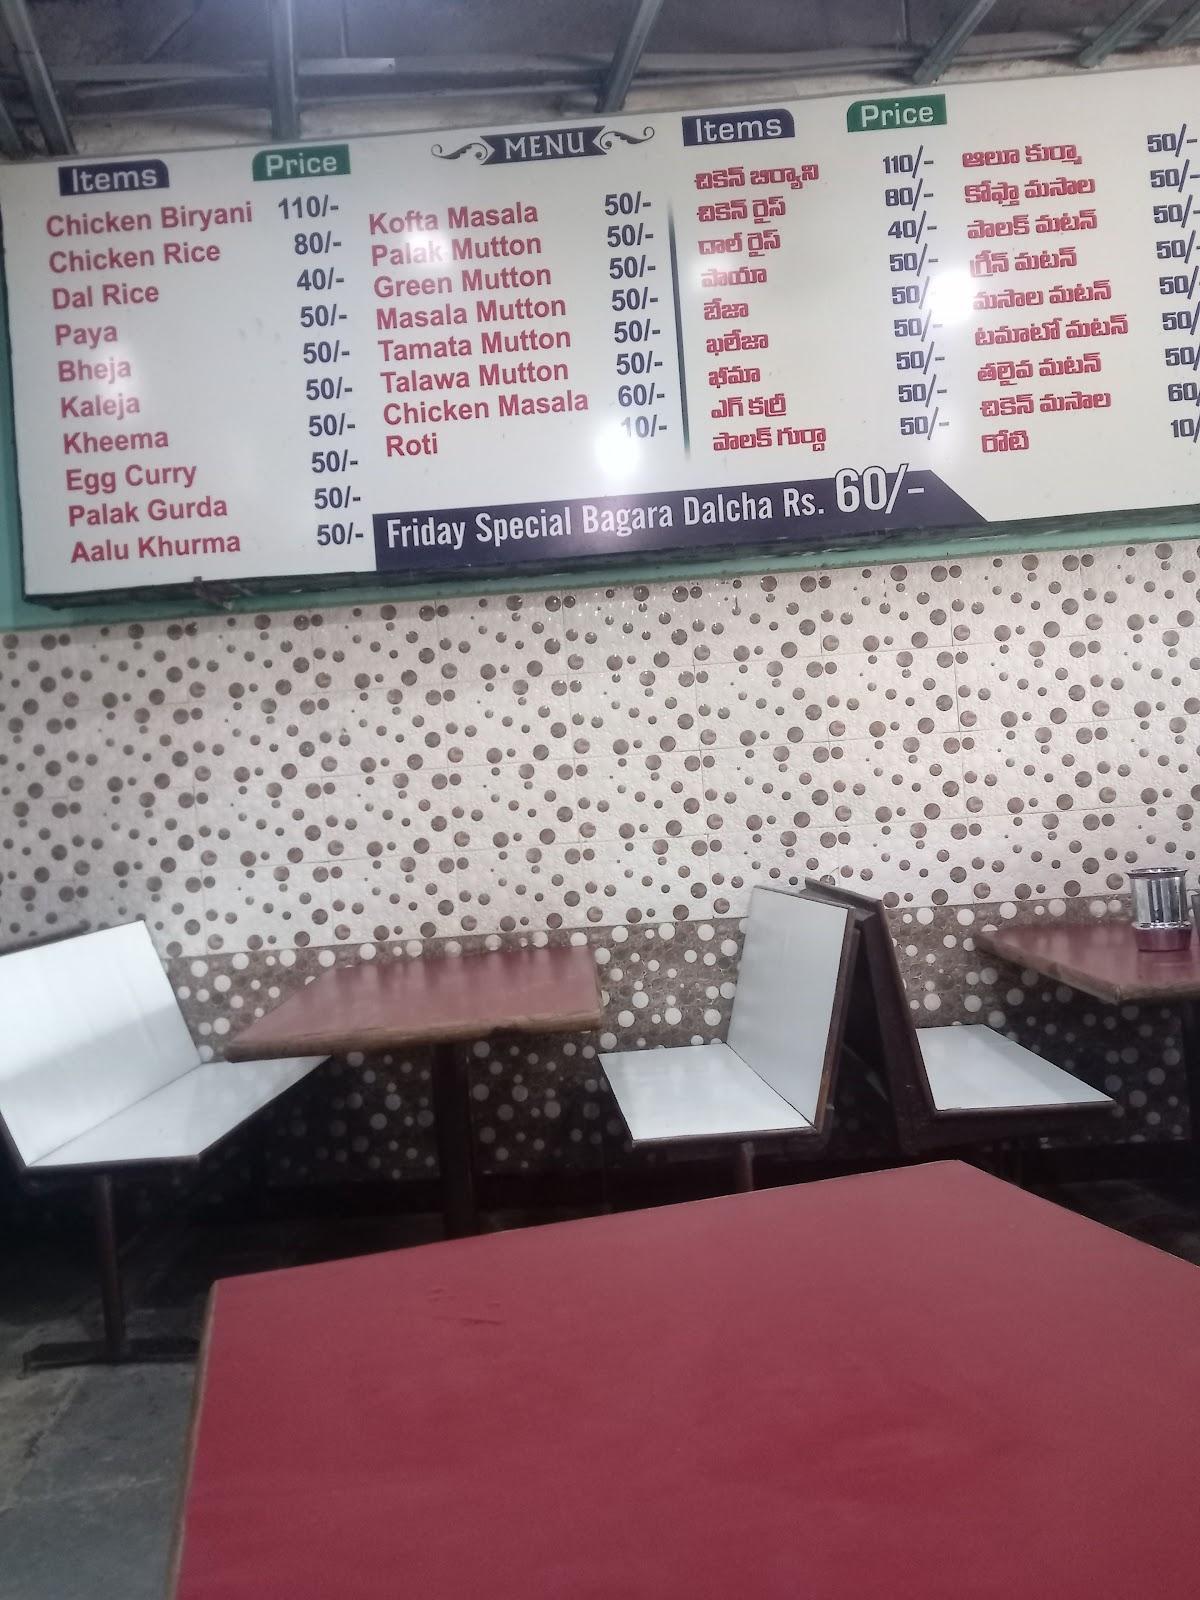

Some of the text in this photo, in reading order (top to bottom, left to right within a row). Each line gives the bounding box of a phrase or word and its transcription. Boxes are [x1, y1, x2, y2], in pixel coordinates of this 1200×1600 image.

[861, 102, 934, 127] Price
[696, 117, 782, 143] Items
[1147, 124, 1197, 157] 50/-
[504, 131, 585, 159] MENU
[266, 152, 338, 177] Price
[883, 145, 933, 179] 110/-
[71, 167, 158, 193] Items
[1150, 159, 1200, 192] 50/-
[279, 195, 338, 219] 110/-
[605, 191, 651, 216] 50/-
[885, 178, 933, 211] 80/-
[46, 201, 252, 237] Chicken Biryani
[369, 203, 537, 235] Kofta Masala
[888, 210, 937, 244] 40/-
[295, 231, 341, 255] 80/-
[608, 223, 653, 247] 50/-
[49, 242, 220, 273] Chicken Rice
[371, 237, 542, 266] Palak Mutton
[890, 243, 938, 276] 50/-
[297, 267, 344, 290] 40/-
[610, 255, 655, 279] 50/-
[53, 283, 159, 310] Dal Rice
[373, 267, 551, 300] Green Mutton
[612, 287, 658, 311] 50/-
[301, 304, 347, 327] 50/-
[376, 300, 565, 329] Masala Mutton
[894, 309, 943, 342] 50/-
[56, 323, 117, 347] Paya
[614, 319, 660, 343] 50/-
[304, 340, 349, 364] 50/-
[380, 330, 570, 361] Tamata Mutton
[896, 342, 944, 375] 50/-
[58, 360, 129, 386] Bheja
[617, 351, 662, 375] 50/-
[306, 377, 352, 400] 50/-
[383, 363, 568, 393] Talawa Mutton
[899, 374, 947, 408] 50/-
[619, 383, 665, 406] 60/-
[61, 396, 139, 422] Kaleja
[384, 392, 588, 426] Chicken Masala
[309, 413, 355, 436] 50/-
[620, 414, 667, 437] 10/-
[900, 407, 948, 440] 50/-
[64, 432, 168, 454] Kheema
[386, 433, 437, 457] Roti
[312, 450, 358, 473] 50/-
[66, 464, 196, 496] Egg Curry
[315, 486, 360, 509] 50/-
[387, 463, 925, 550] Friday Special Bagara Dalcha Rs. 60/-
[69, 496, 228, 526] Palak Gurda
[318, 522, 363, 545] 50/-
[72, 536, 240, 561] Aalu Khurma
